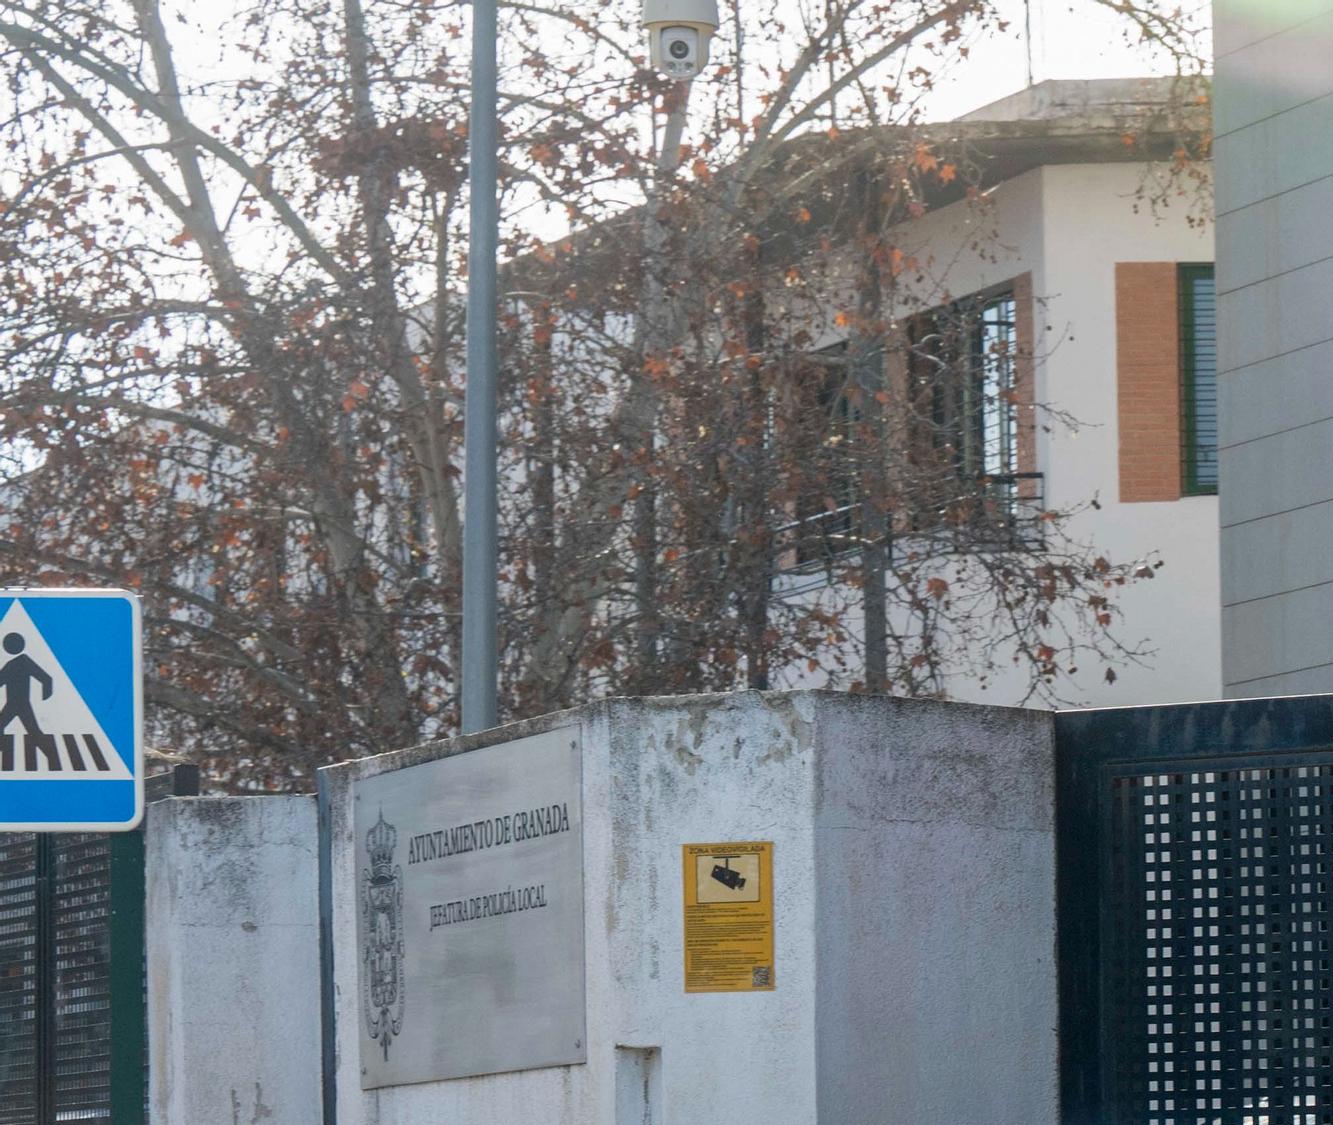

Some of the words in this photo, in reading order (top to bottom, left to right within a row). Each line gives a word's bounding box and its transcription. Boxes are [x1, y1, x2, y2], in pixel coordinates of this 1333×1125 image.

[408, 819, 495, 865] AYUNTAMIENTO
[495, 815, 512, 846] DE
[513, 803, 570, 842] GRANADA
[688, 847, 709, 855] ZONA
[430, 901, 468, 932] JEFATURA
[469, 898, 482, 920] DE
[482, 885, 517, 916] POLICÍA
[517, 885, 548, 911] LOCAL
